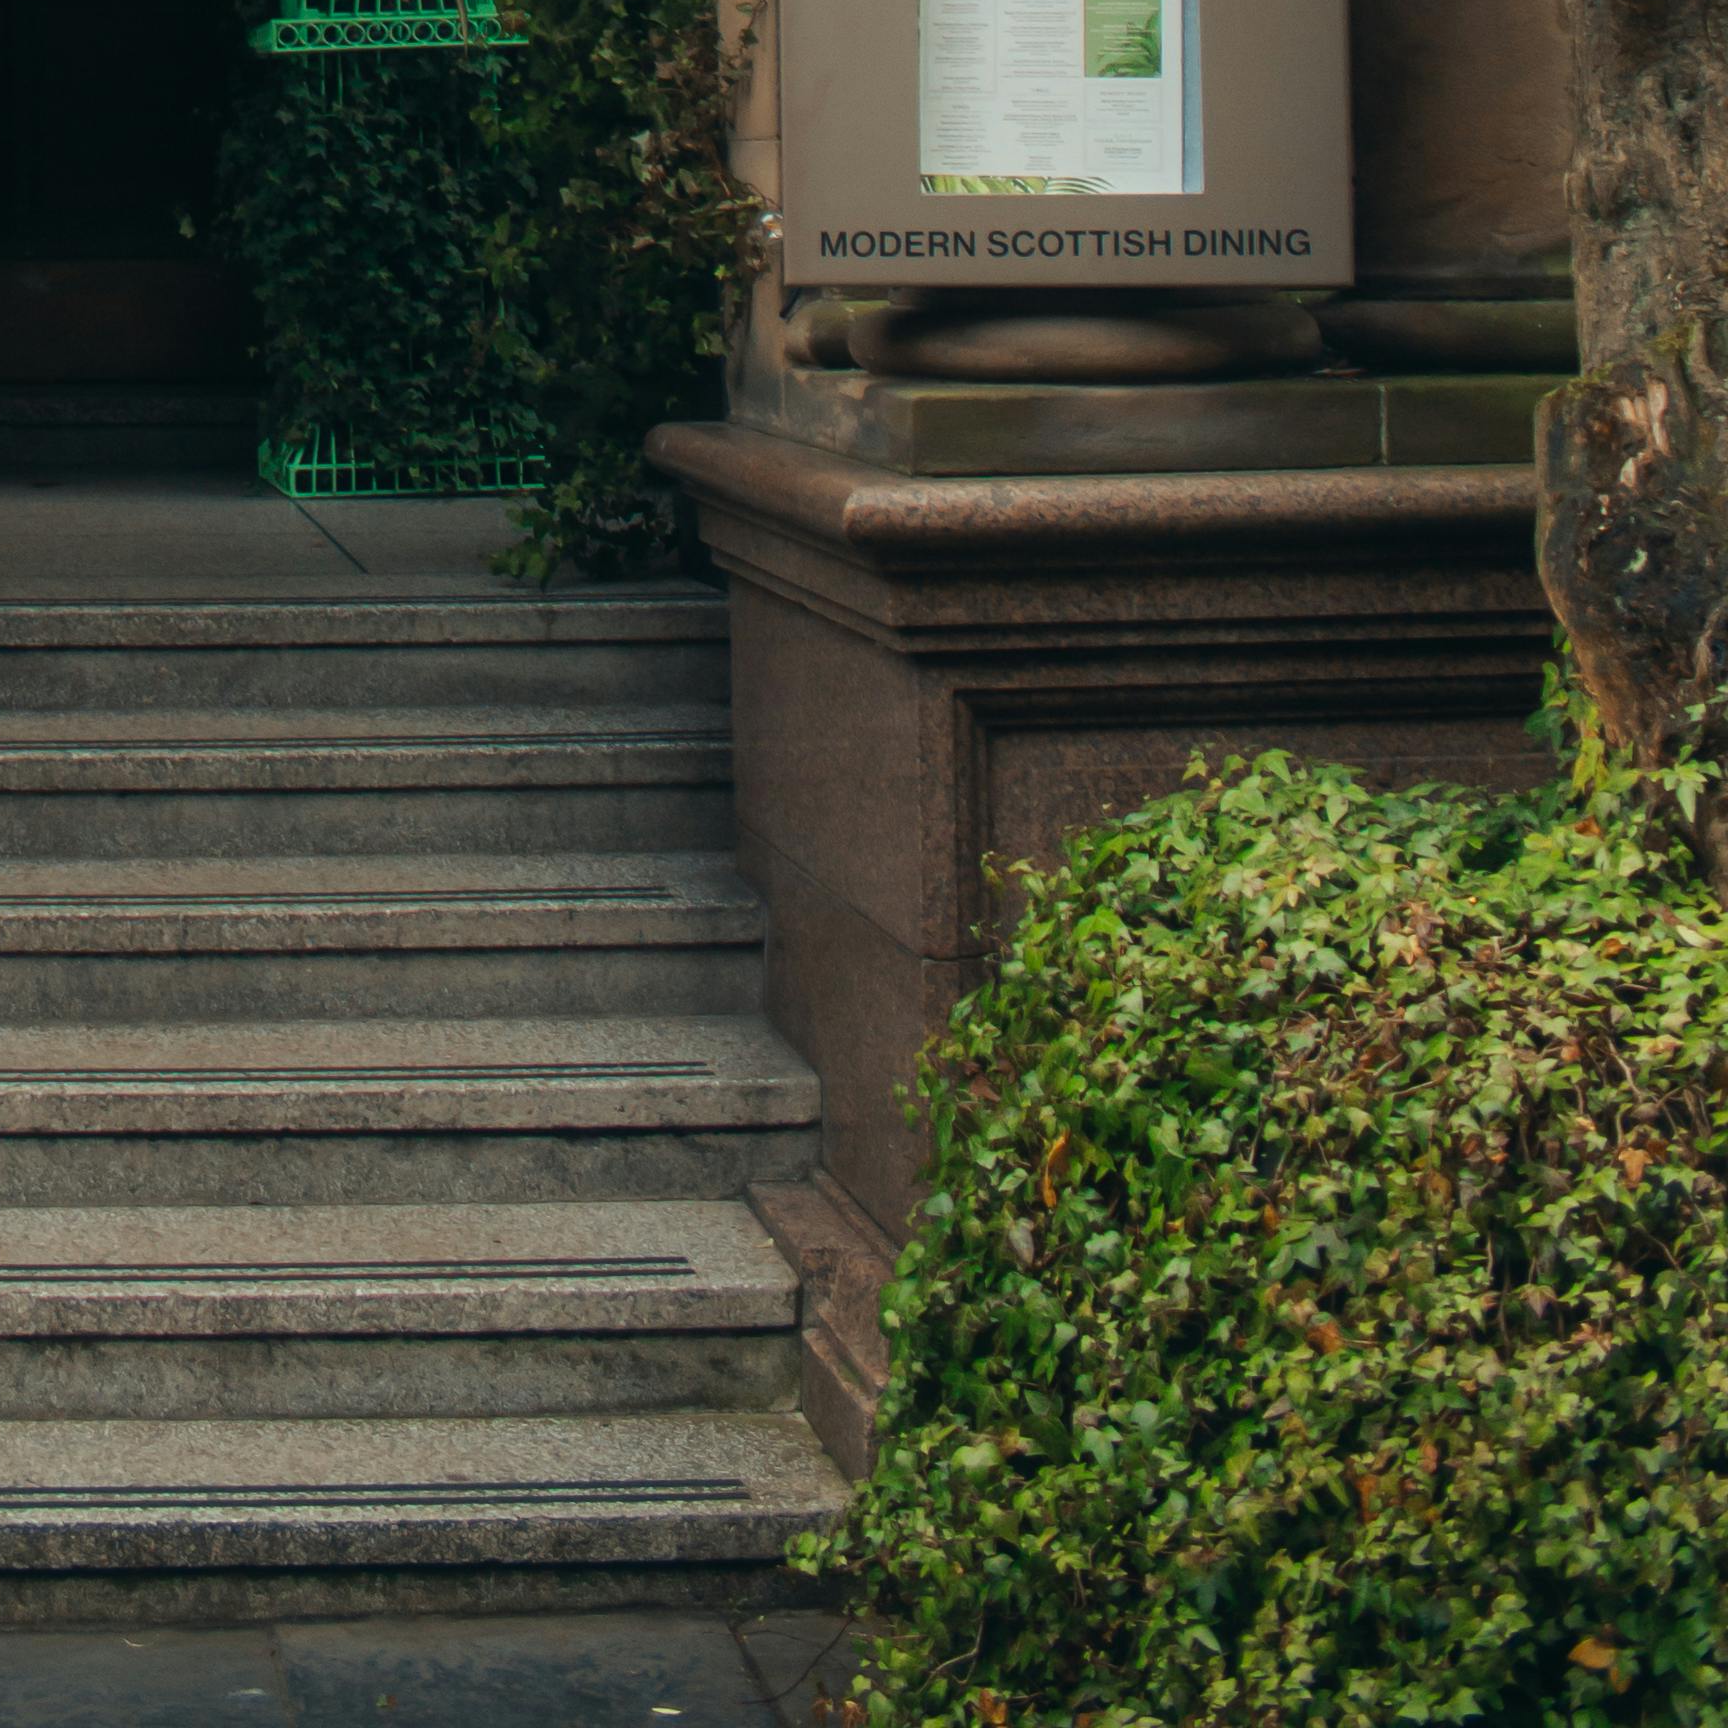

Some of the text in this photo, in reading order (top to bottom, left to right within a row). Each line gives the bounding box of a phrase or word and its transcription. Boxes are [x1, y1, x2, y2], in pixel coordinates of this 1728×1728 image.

[820, 228, 1312, 260] MODERN SCOTTISH DINING
